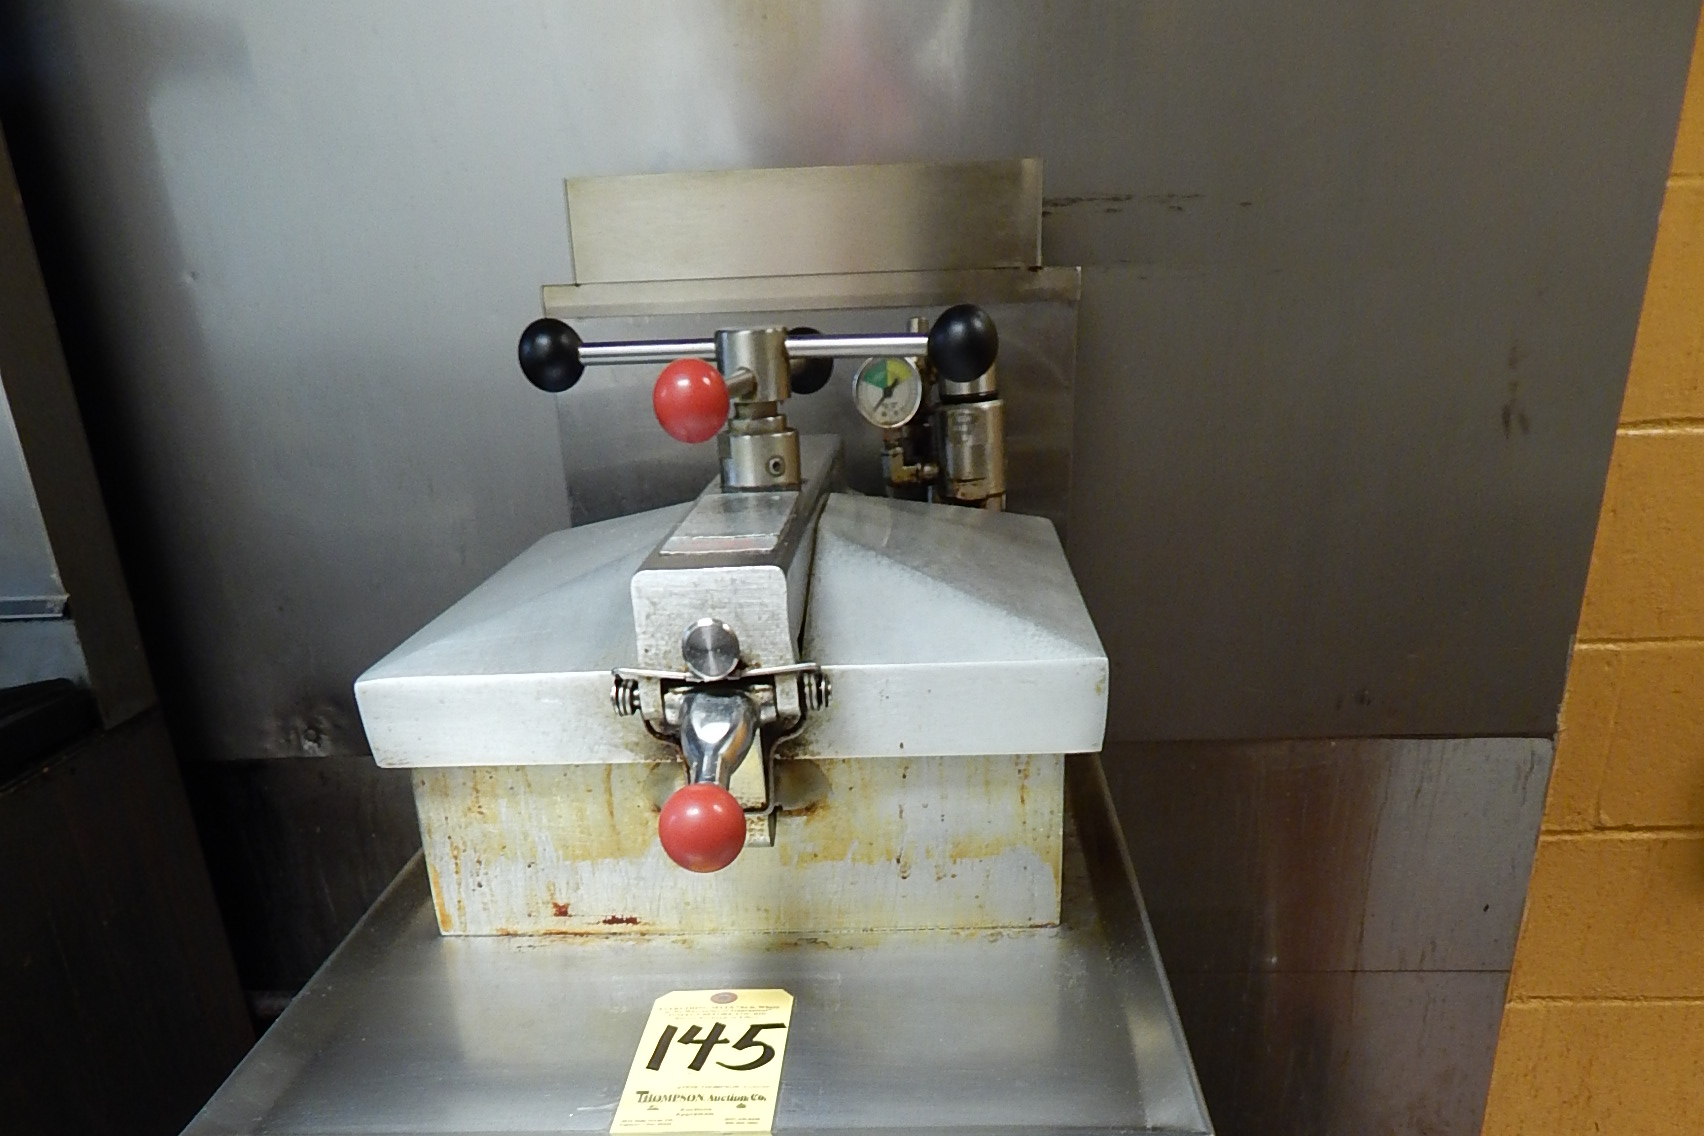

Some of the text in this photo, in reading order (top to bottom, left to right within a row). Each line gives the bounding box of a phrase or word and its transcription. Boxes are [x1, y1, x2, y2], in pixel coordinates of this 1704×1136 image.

[646, 1022, 787, 1071] 145
[636, 1091, 704, 1103] THOMPSON
[708, 1093, 749, 1103] Auction
